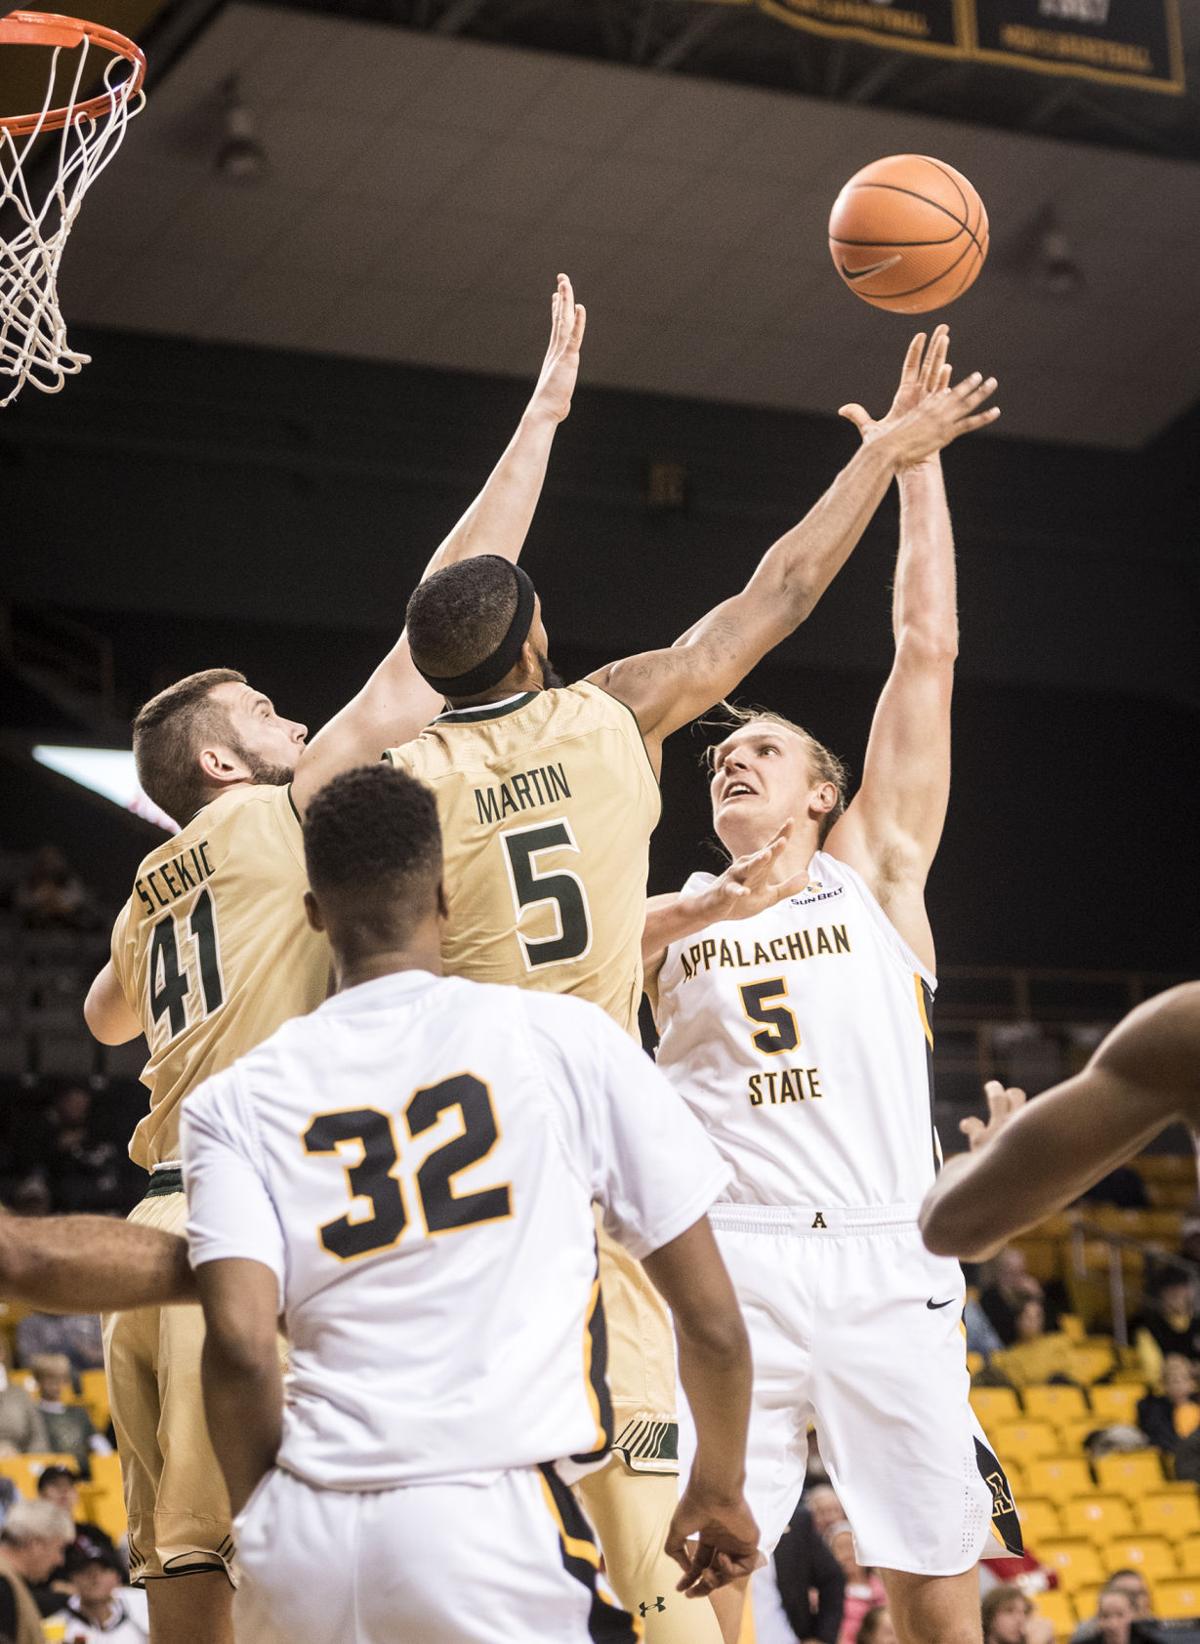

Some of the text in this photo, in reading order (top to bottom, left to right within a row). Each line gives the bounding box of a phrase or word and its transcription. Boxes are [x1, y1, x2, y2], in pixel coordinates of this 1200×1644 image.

[474, 763, 571, 824] MARTIN
[135, 841, 215, 915] SCEKIC
[499, 817, 592, 972] 5
[149, 884, 226, 1039] 41
[681, 925, 851, 983] APPALACHIAN
[738, 976, 801, 1056] 5
[749, 1068, 823, 1106] STATE
[301, 1071, 514, 1263] 32
[811, 1212, 827, 1229] A
